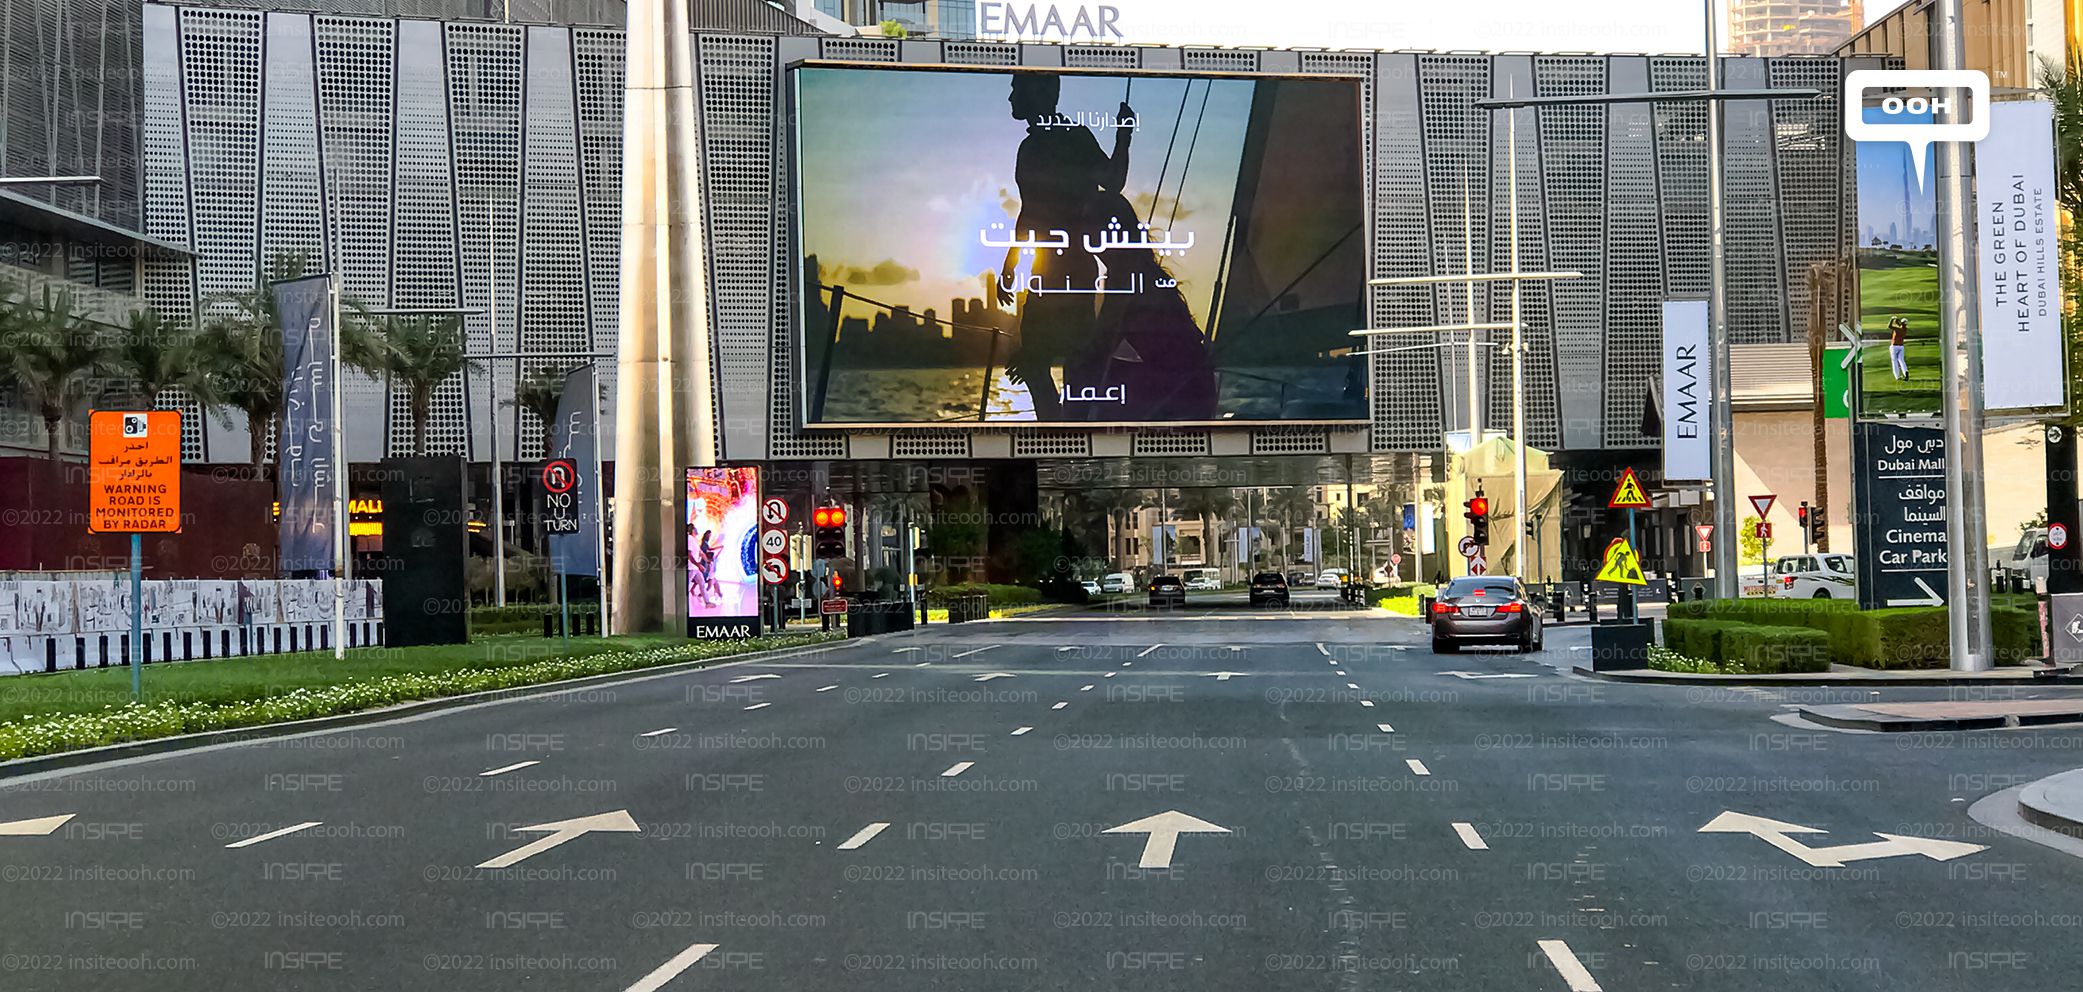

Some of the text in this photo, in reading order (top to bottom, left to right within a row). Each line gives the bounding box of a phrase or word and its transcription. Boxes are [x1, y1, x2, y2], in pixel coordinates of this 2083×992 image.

[980, 2, 1124, 37] EMAAR
[1036, 111, 1140, 132] إصدارنا الجديد
[979, 216, 1195, 257] بيتش جيت
[1992, 201, 2007, 307] THE GREEN
[2012, 174, 2030, 332] HEART OF DUBAI
[2033, 188, 2047, 316] DUBAI HILLS ESTATE
[1154, 276, 1178, 289] من
[1058, 384, 1125, 405] إعمار
[1676, 344, 1698, 439] EMAAR
[1885, 434, 1944, 454] دبي مول
[1877, 457, 1945, 471] Dubai Mall
[104, 484, 167, 494] WARNING
[1898, 484, 1946, 505] مواقف
[109, 495, 161, 506] ROAD IS
[546, 493, 571, 508] NO
[95, 507, 175, 517] MONITORED
[553, 507, 566, 520] U
[1904, 505, 1946, 526] السينما
[103, 519, 167, 529] BY RADAR
[543, 519, 577, 532] TURN
[765, 536, 782, 547] 40
[1885, 529, 1947, 544] Cinema
[1879, 548, 1947, 565] Car Park
[696, 624, 751, 639] EMAAR
